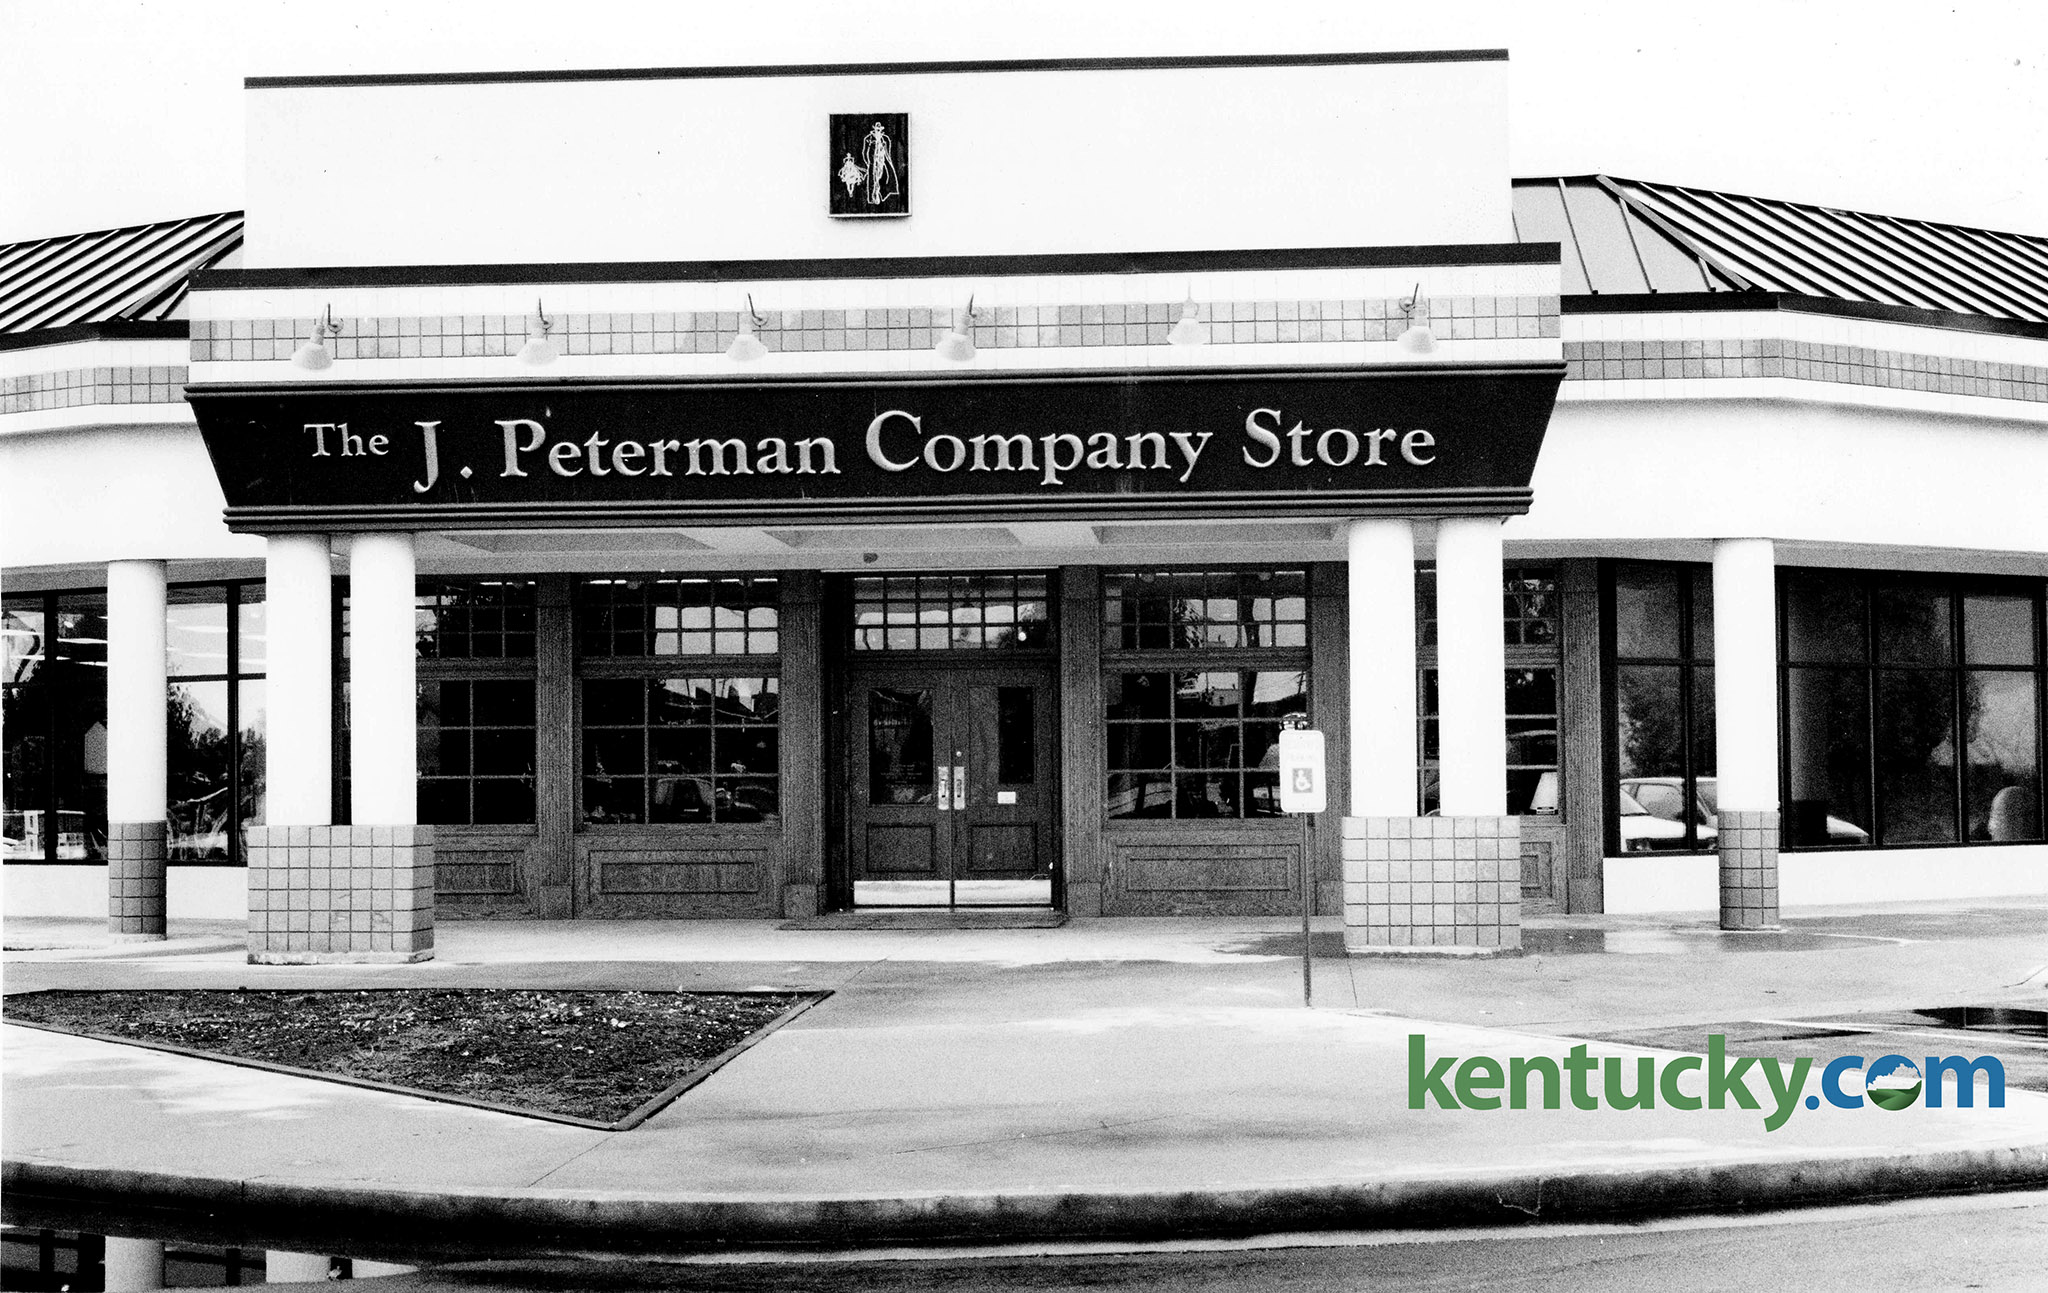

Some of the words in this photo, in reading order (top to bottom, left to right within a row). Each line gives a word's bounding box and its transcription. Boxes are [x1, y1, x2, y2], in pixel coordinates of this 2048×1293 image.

[303, 423, 389, 457] The
[413, 420, 473, 493] J.
[495, 418, 842, 478] Peterman
[865, 409, 1214, 486] Company
[1242, 407, 1436, 468] Store
